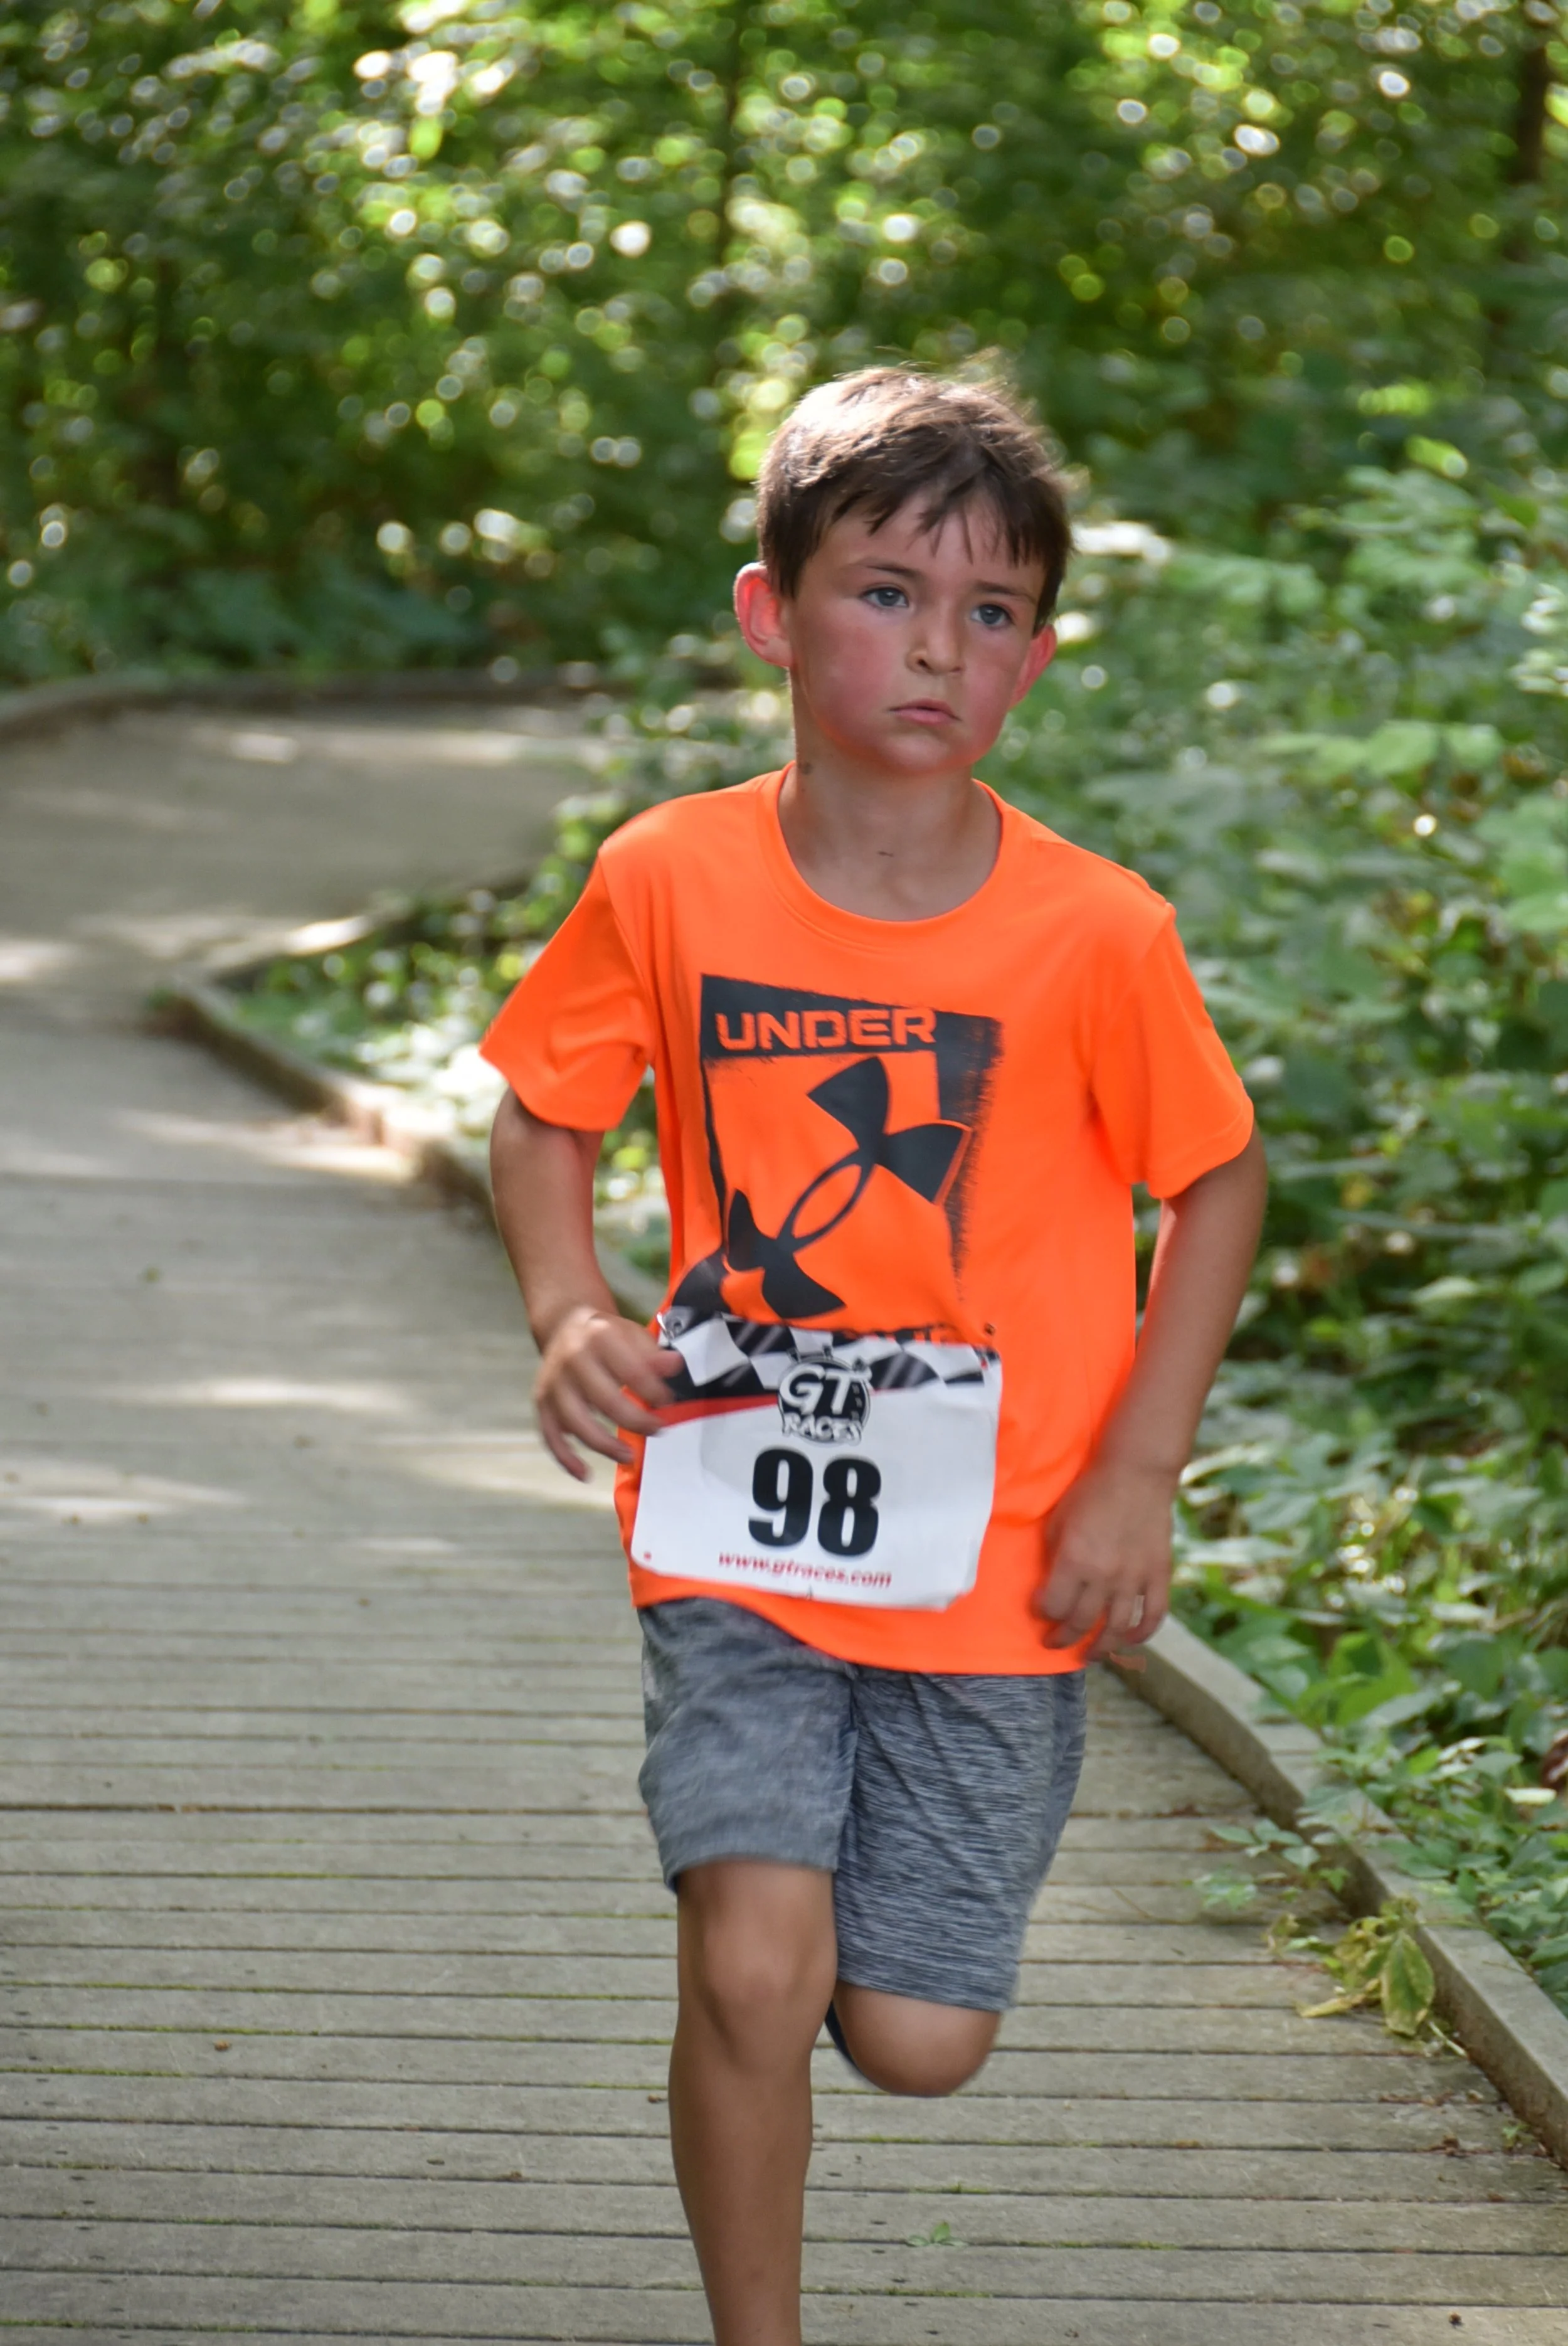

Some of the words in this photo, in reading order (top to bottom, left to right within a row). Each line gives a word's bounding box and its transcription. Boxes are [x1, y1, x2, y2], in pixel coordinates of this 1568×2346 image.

[715, 1008, 936, 1051] UNDER
[779, 1362, 872, 1416] GT
[748, 1446, 882, 1557] 98
[718, 1551, 893, 1588] www.gtraces.com
